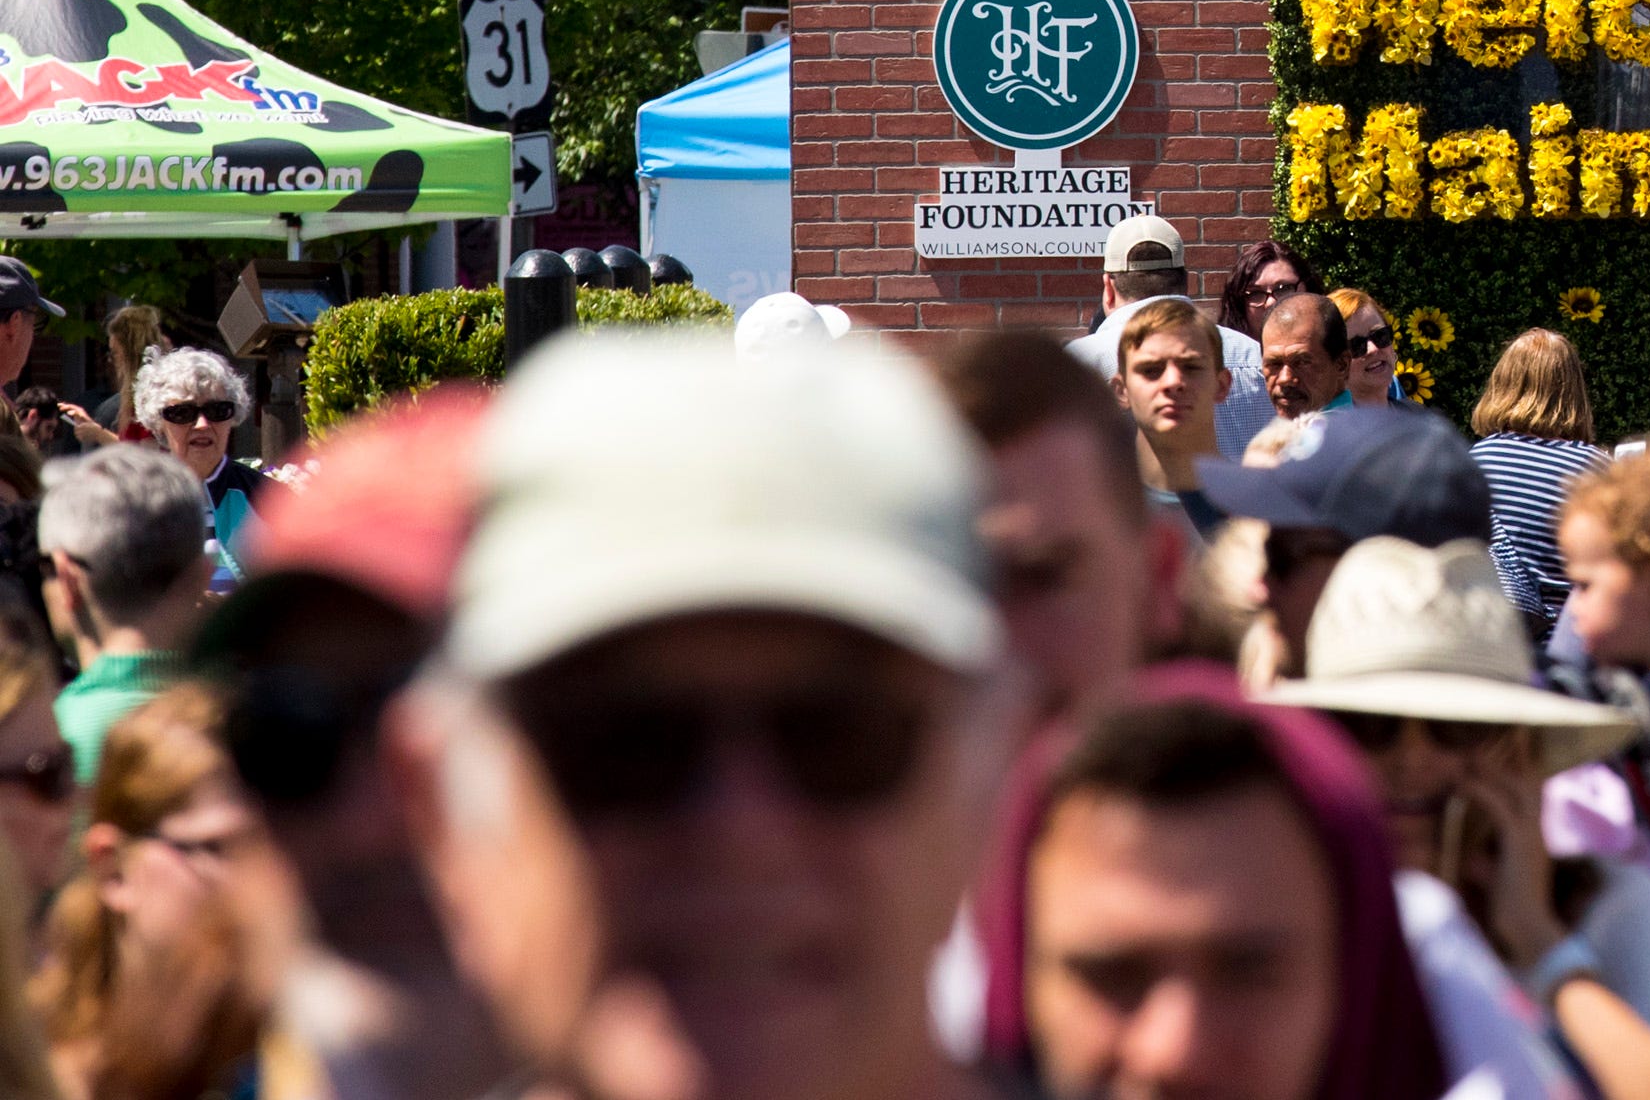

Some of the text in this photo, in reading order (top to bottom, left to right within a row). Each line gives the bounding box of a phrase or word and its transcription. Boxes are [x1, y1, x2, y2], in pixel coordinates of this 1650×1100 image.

[482, 18, 532, 88] 31
[941, 170, 1129, 195] HERITAGE
[1044, 241, 1107, 256] COUNT
